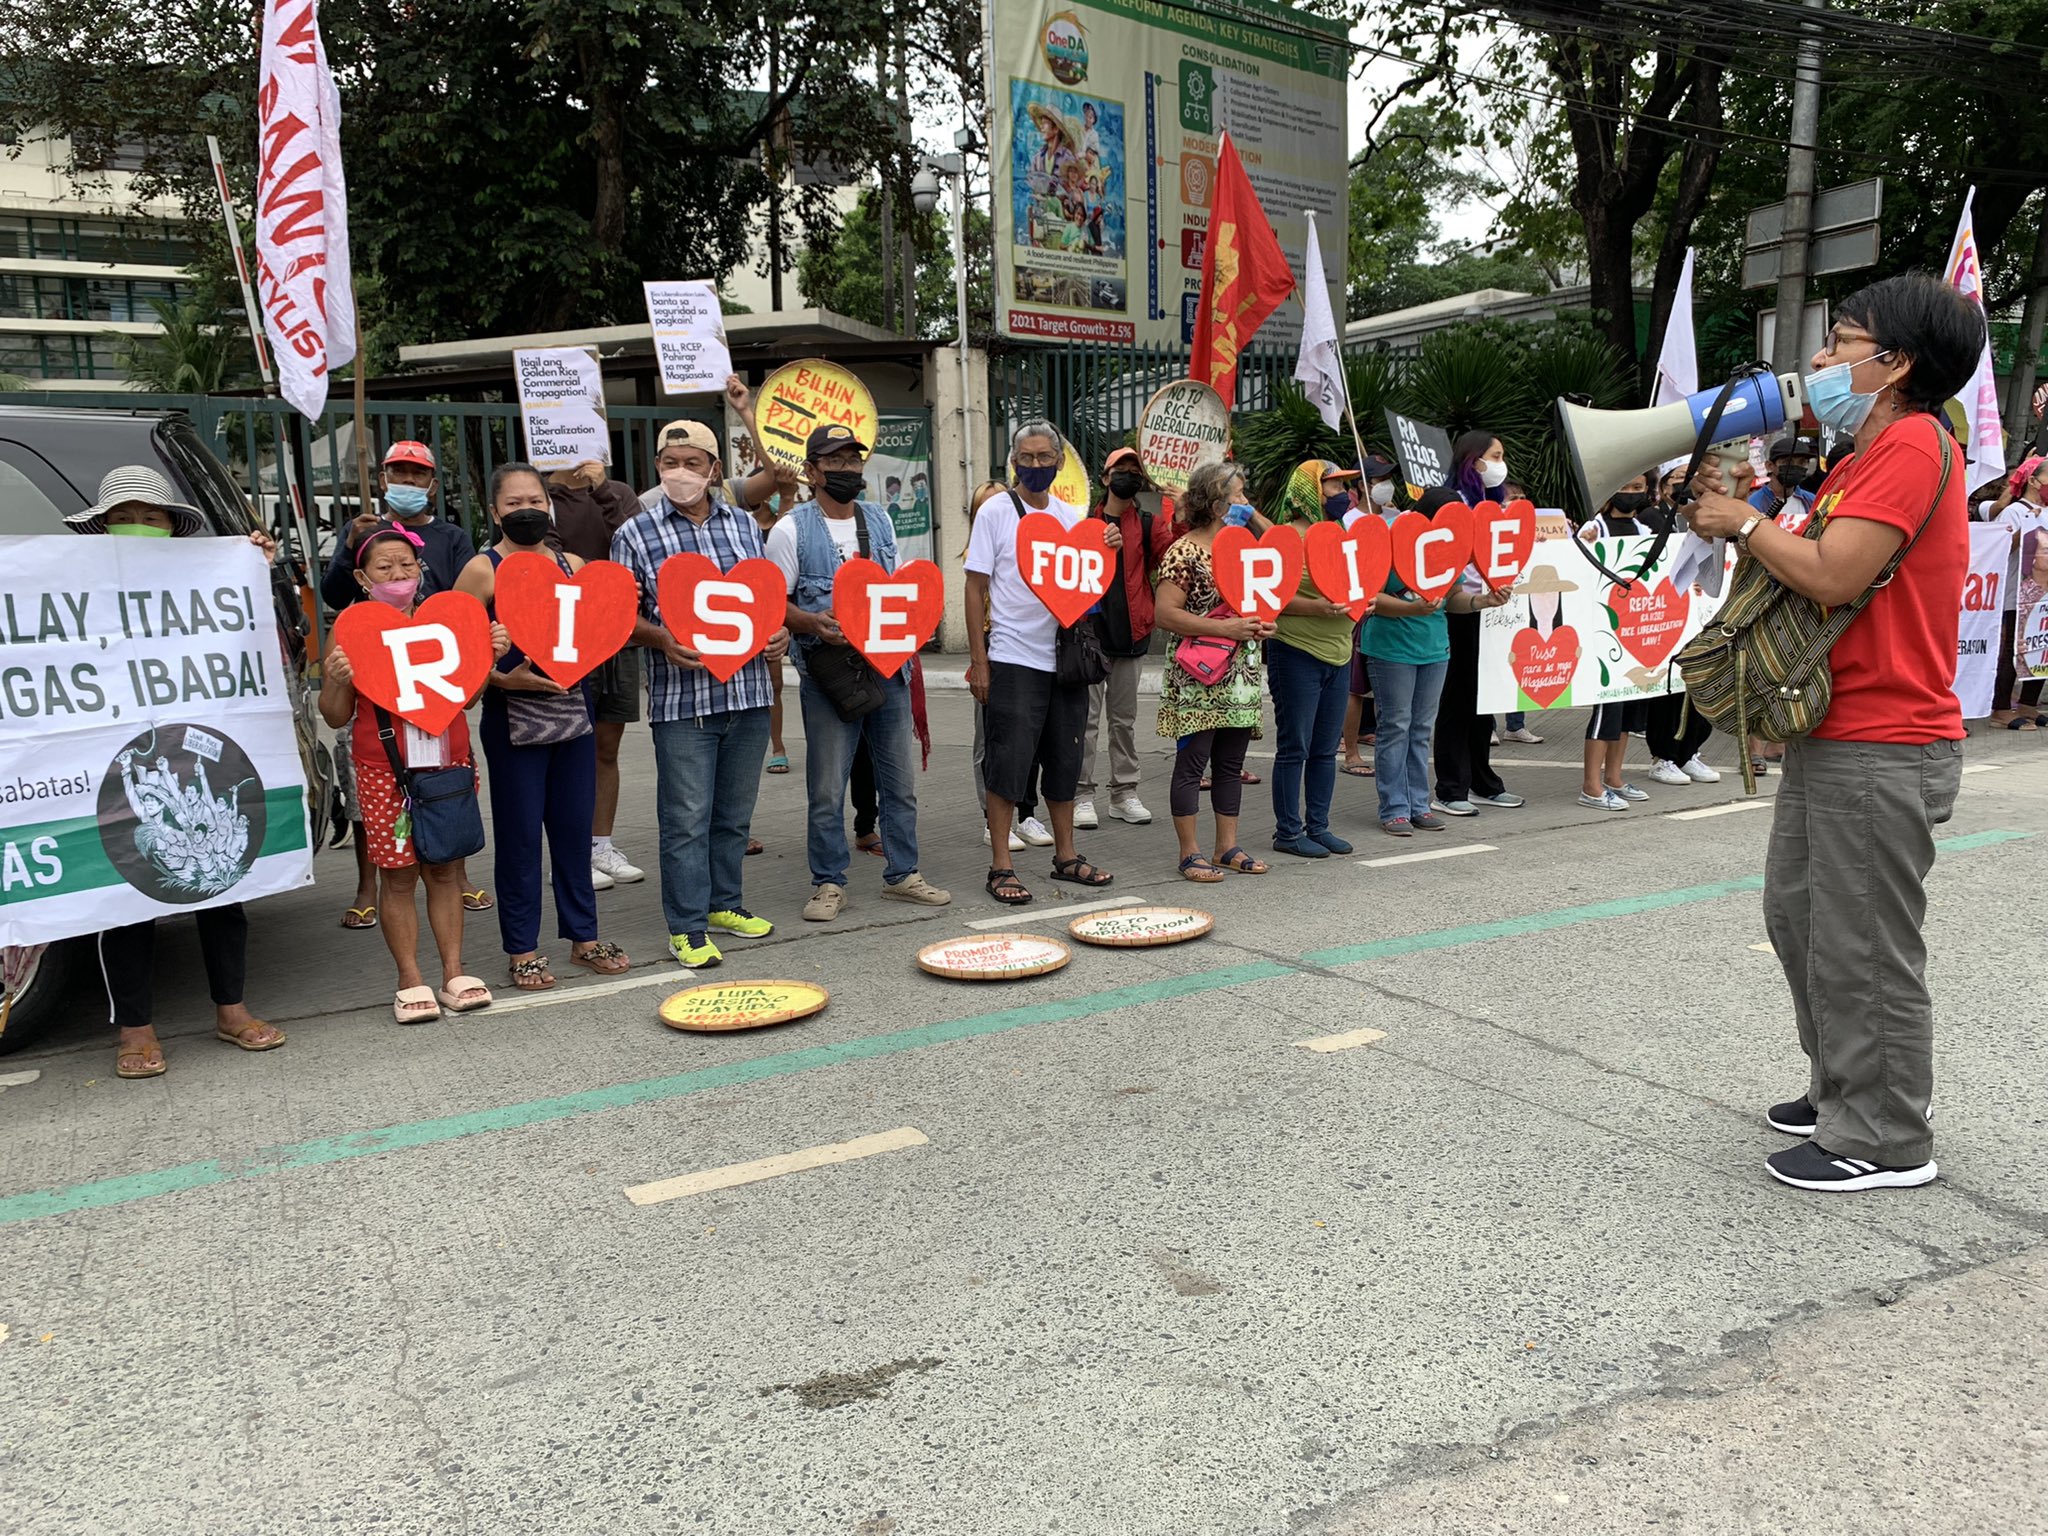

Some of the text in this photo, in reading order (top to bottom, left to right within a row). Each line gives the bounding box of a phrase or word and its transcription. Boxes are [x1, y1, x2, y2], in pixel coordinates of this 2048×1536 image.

[1048, 30, 1085, 52] OneDA
[1219, 22, 1239, 41] KEY
[1241, 29, 1299, 59] STRATEGIES
[1182, 43, 1260, 77] CONSOLIDATION
[652, 298, 678, 306] banta
[654, 306, 696, 318] seguridad
[655, 315, 694, 327] pagkain!
[1011, 314, 1131, 338] 2021 Target Growth: 2.5%
[520, 357, 562, 369] Itigil ang
[663, 352, 696, 362] Pahirap
[522, 367, 579, 378] Golden Rice
[666, 370, 714, 382] Magsasaka
[676, 363, 695, 373] mga
[523, 376, 581, 388] Commercial
[796, 368, 855, 405] BILHIN
[524, 386, 587, 400] Propagation!
[1167, 386, 1203, 405] NO TO
[773, 382, 866, 428] ANG PALAY
[1164, 401, 1194, 420] RICE
[529, 416, 549, 425] Rice
[1144, 412, 1226, 445] LIBERALIZATION
[530, 425, 595, 436] Liberalization
[1397, 416, 1420, 444] RA
[876, 435, 913, 447] OCOLS
[1149, 434, 1200, 455] DEFEND
[532, 445, 578, 456] IBASURA!
[1143, 449, 1159, 465] PH
[1402, 441, 1440, 468] 11203
[1960, 572, 1999, 612] an
[1629, 594, 1667, 613] REPEAL
[0, 586, 256, 650] LAY, ITAAS!
[381, 622, 465, 713] R
[552, 585, 582, 663] I
[692, 580, 755, 655] S
[864, 583, 918, 653] E
[1030, 540, 1104, 595] FOR
[1239, 547, 1283, 613] R
[1342, 539, 1364, 602] I
[1414, 527, 1456, 591] C
[1488, 519, 1521, 578] E
[2025, 632, 2048, 650] PRES
[1530, 645, 1558, 661] Puso
[1523, 664, 1541, 675] para
[0, 650, 268, 720] GAS, IBABA!
[1127, 916, 1148, 924] TO
[944, 941, 1014, 959] PROMOTOR
[686, 995, 789, 1006] SUBSIDYO
